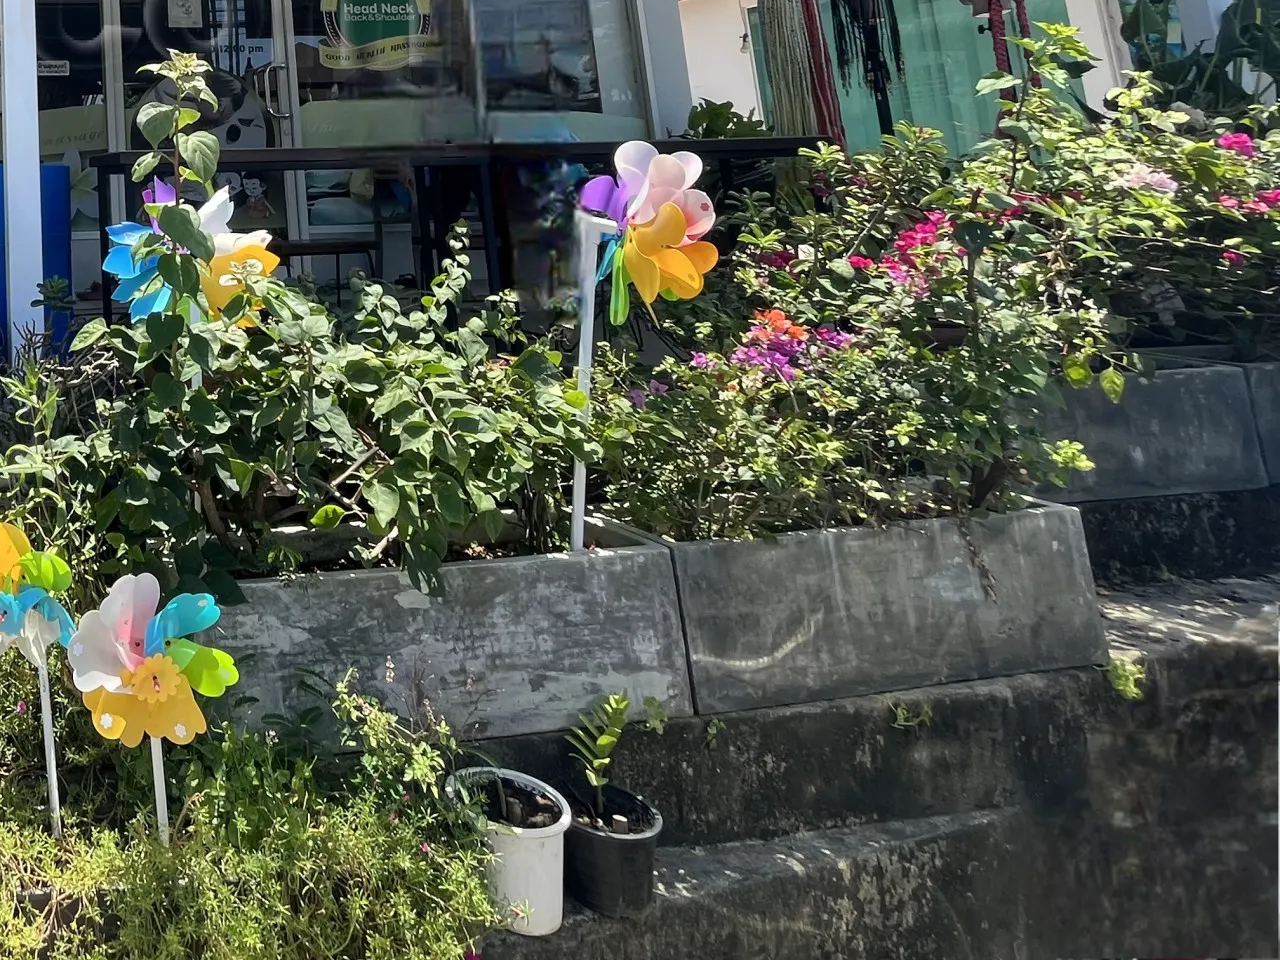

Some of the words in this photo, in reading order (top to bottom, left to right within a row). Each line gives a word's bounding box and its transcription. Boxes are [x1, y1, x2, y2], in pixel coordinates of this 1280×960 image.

[344, 2, 377, 14] Head
[381, 3, 414, 14] Neck
[248, 45, 264, 55] pm
